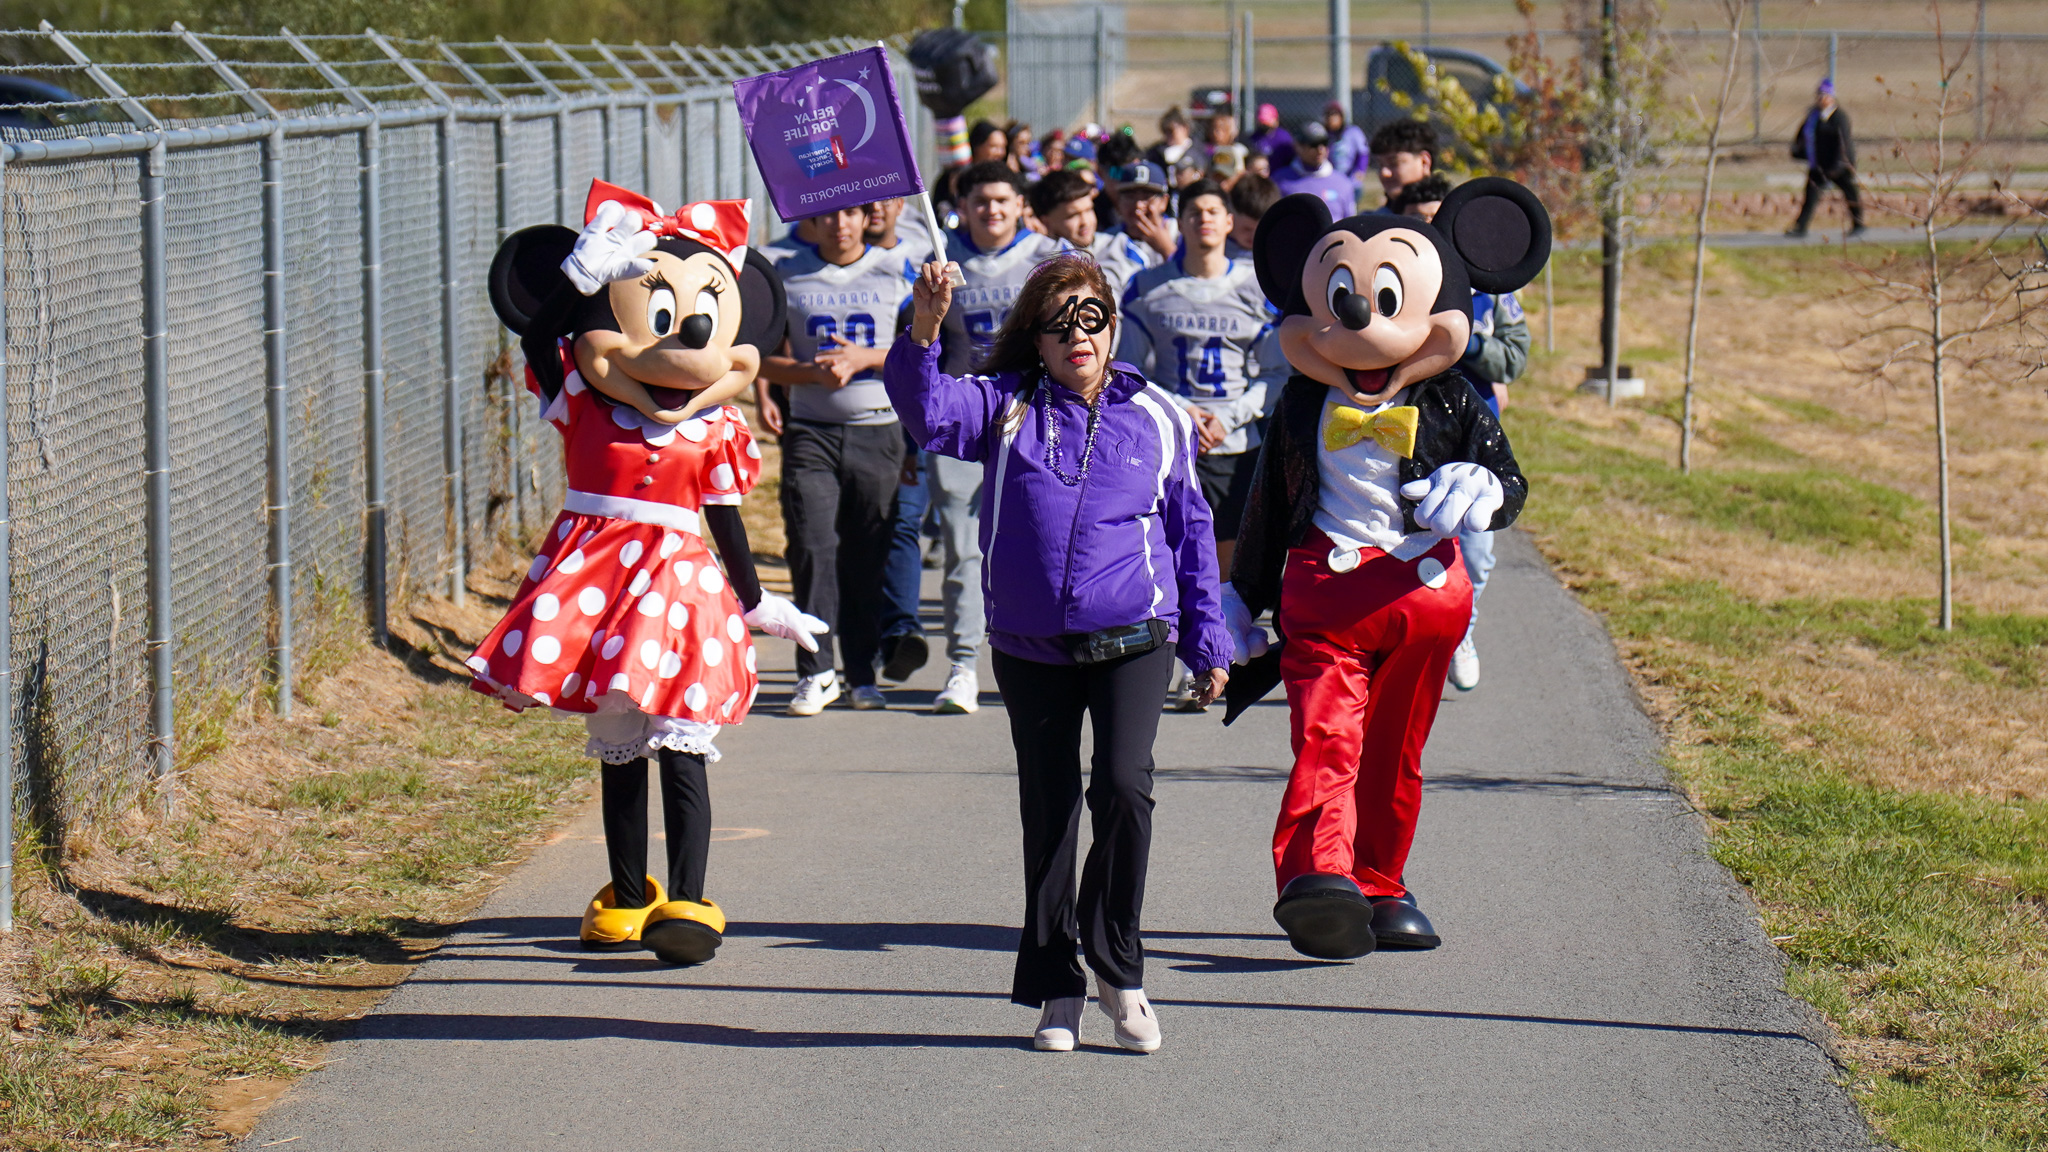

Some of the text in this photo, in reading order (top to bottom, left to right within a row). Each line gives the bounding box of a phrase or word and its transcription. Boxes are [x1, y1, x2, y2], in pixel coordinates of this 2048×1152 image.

[1135, 165, 1150, 185] D
[799, 292, 881, 307] CIGARROA
[1041, 295, 1111, 344] 40
[1172, 336, 1227, 398] 14
